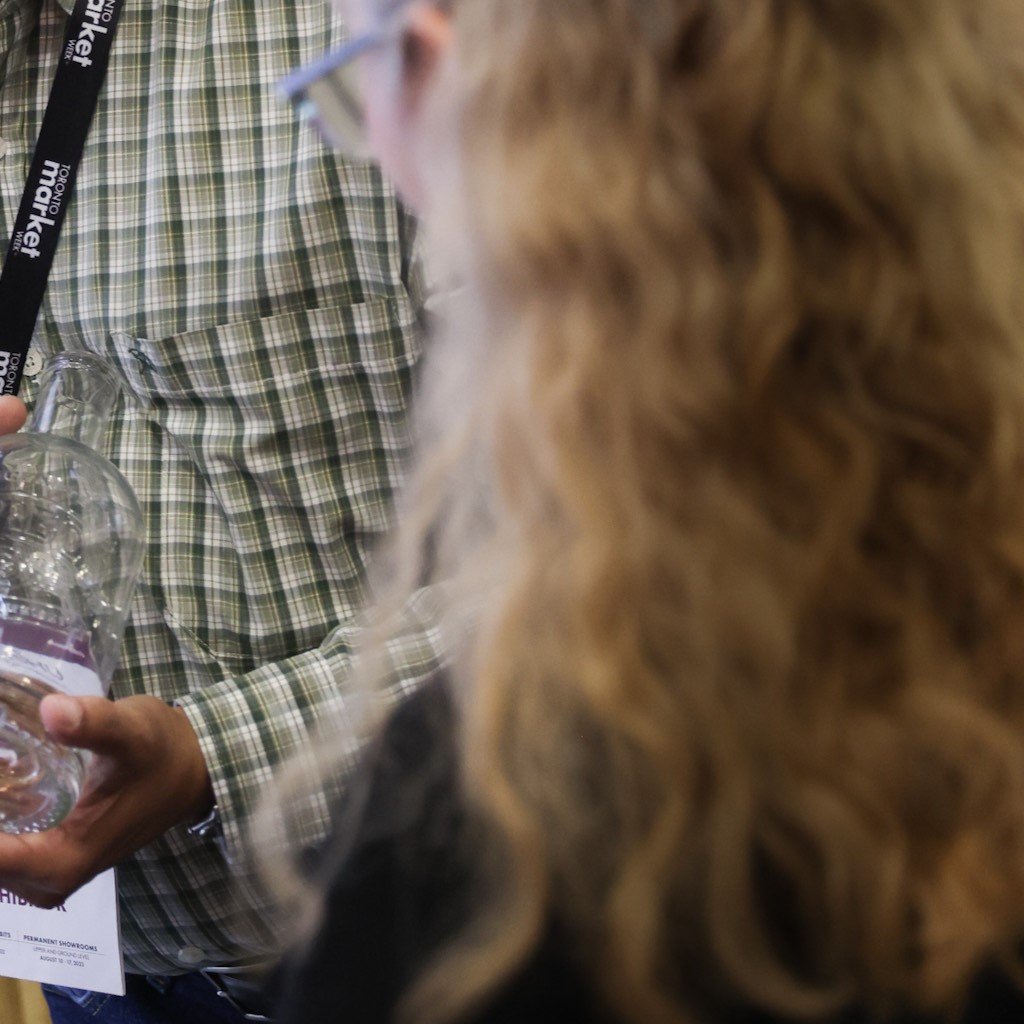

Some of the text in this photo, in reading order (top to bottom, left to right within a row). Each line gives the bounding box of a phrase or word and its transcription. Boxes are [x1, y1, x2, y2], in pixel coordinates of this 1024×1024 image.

[64, 39, 77, 61] WEEK
[48, 163, 72, 216] TORONTO
[20, 159, 56, 259] market
[12, 230, 25, 252] WEEK
[4, 352, 22, 395] TORONT
[23, 934, 98, 952] PERMANENT SHOWROOMS
